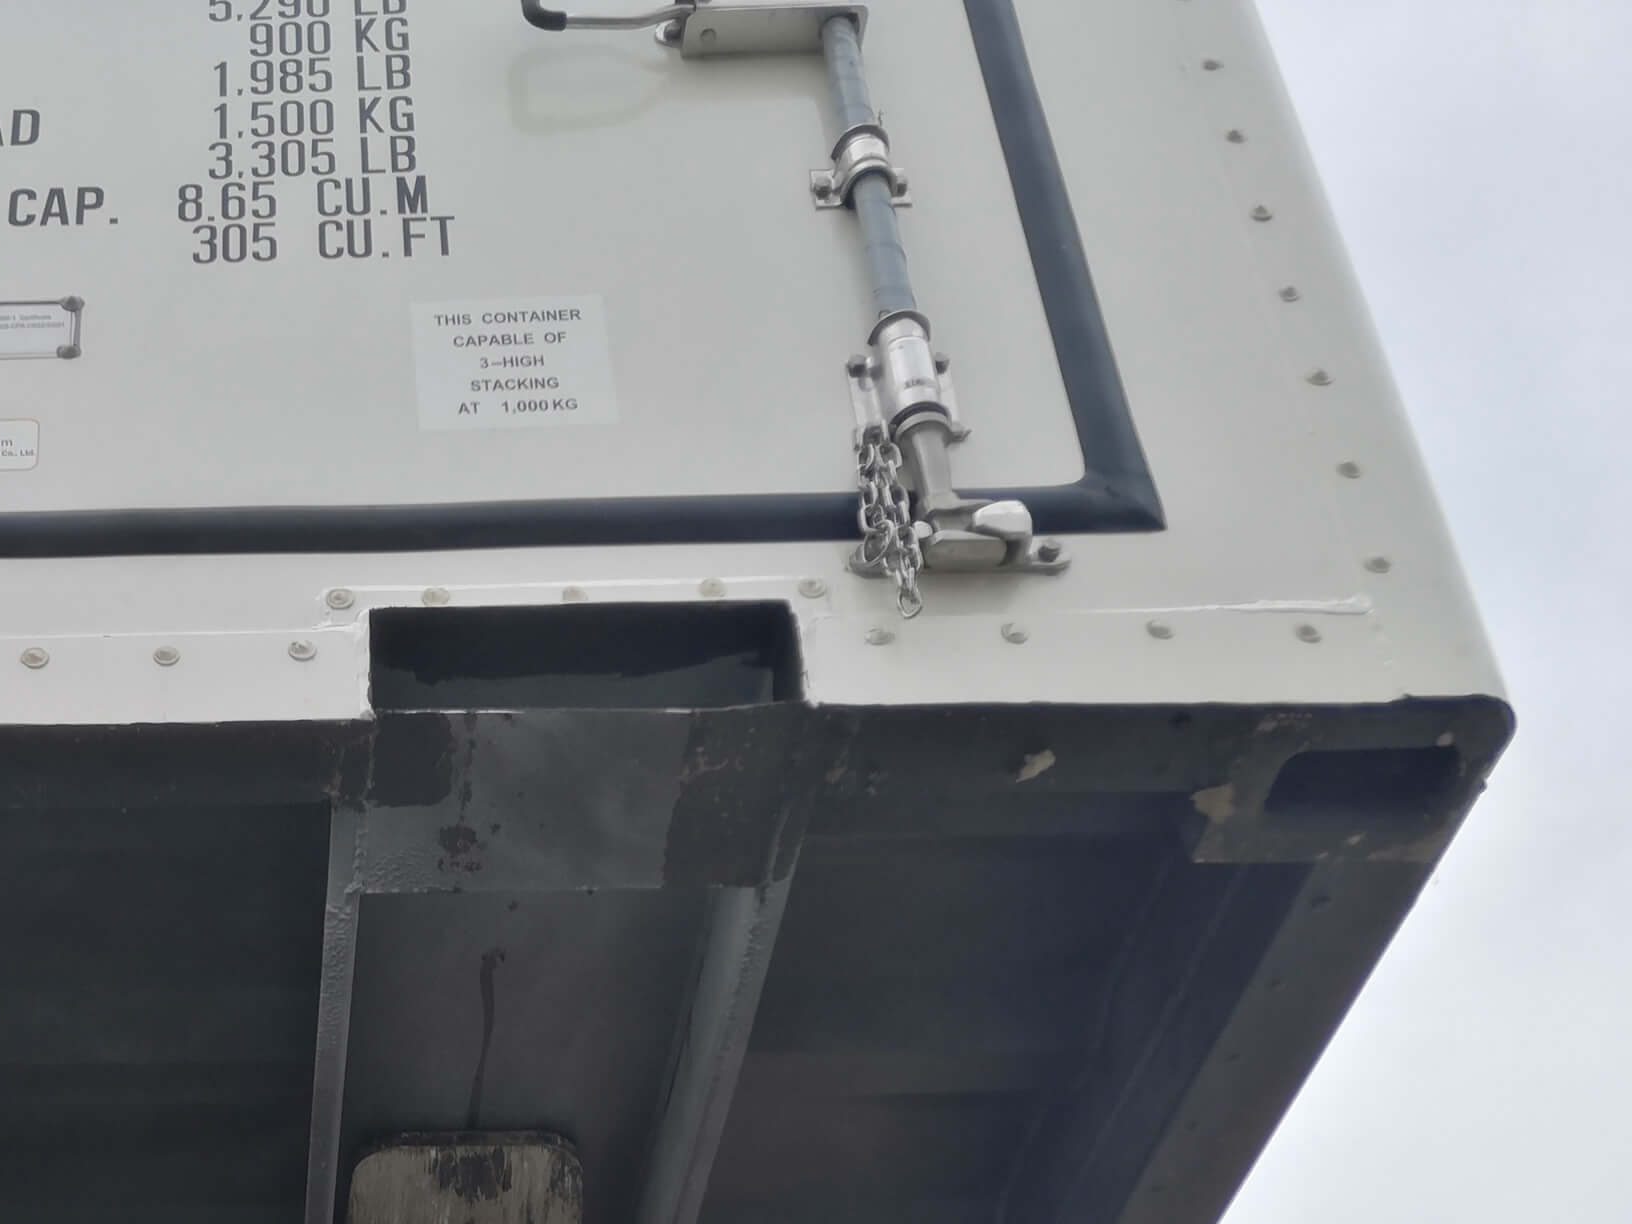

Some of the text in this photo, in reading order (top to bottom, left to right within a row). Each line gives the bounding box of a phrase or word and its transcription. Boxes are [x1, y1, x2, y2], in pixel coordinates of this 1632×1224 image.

[249, 17, 410, 57] 900 KG
[356, 54, 411, 91] LB
[358, 95, 415, 134] KG
[360, 135, 416, 174] LB
[8, 186, 118, 226] CAP.
[178, 180, 277, 222] 8.65
[192, 215, 455, 264] 305 CU.FT
[434, 309, 582, 326] THIS CONTAINER
[453, 331, 567, 348] CAPABLE OF
[470, 376, 560, 392] STACKING
[458, 401, 480, 415] AT
[553, 398, 578, 411] KG
